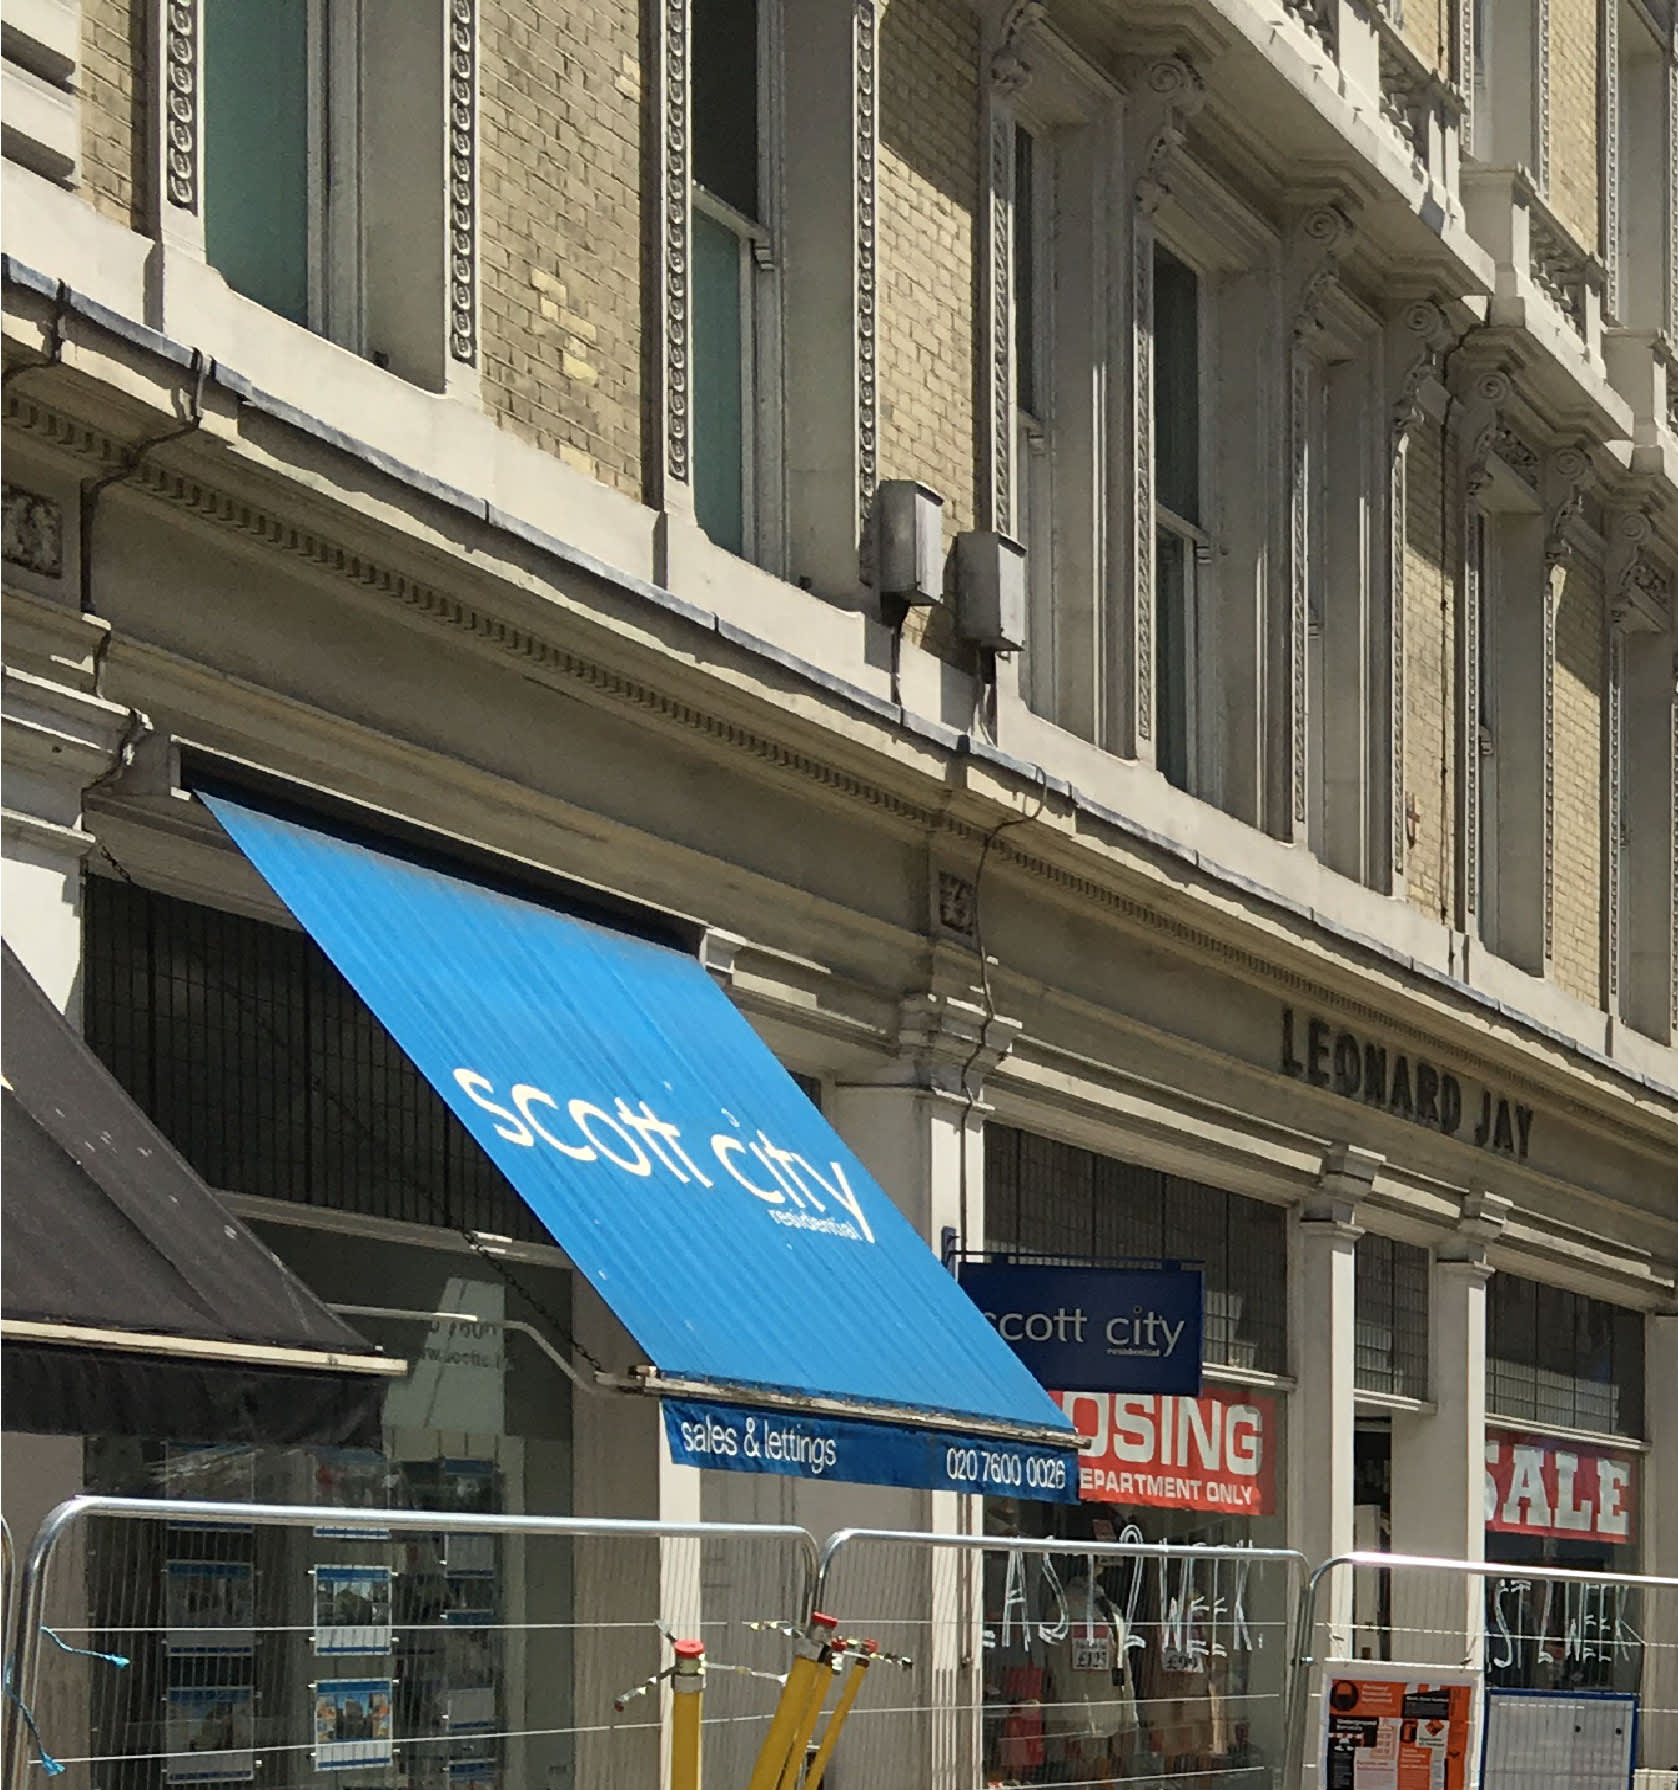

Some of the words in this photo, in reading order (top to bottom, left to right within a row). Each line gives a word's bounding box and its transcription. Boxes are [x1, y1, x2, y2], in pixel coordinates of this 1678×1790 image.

[1281, 1003, 1462, 1136] LEONARD
[1474, 1089, 1534, 1160] JAY
[453, 1068, 714, 1188] scott
[710, 1107, 875, 1243] city
[1106, 1305, 1185, 1357] city
[680, 1419, 737, 1456] sales
[744, 1416, 761, 1458] &
[764, 1418, 837, 1475] lettings
[946, 1447, 977, 1481] 020
[982, 1450, 1022, 1487] 7600
[1026, 1454, 1067, 1490] 0026
[1080, 1467, 1203, 1501] EPARTMENT
[1206, 1482, 1253, 1506] ONLY
[1485, 1579, 1532, 1672] ST
